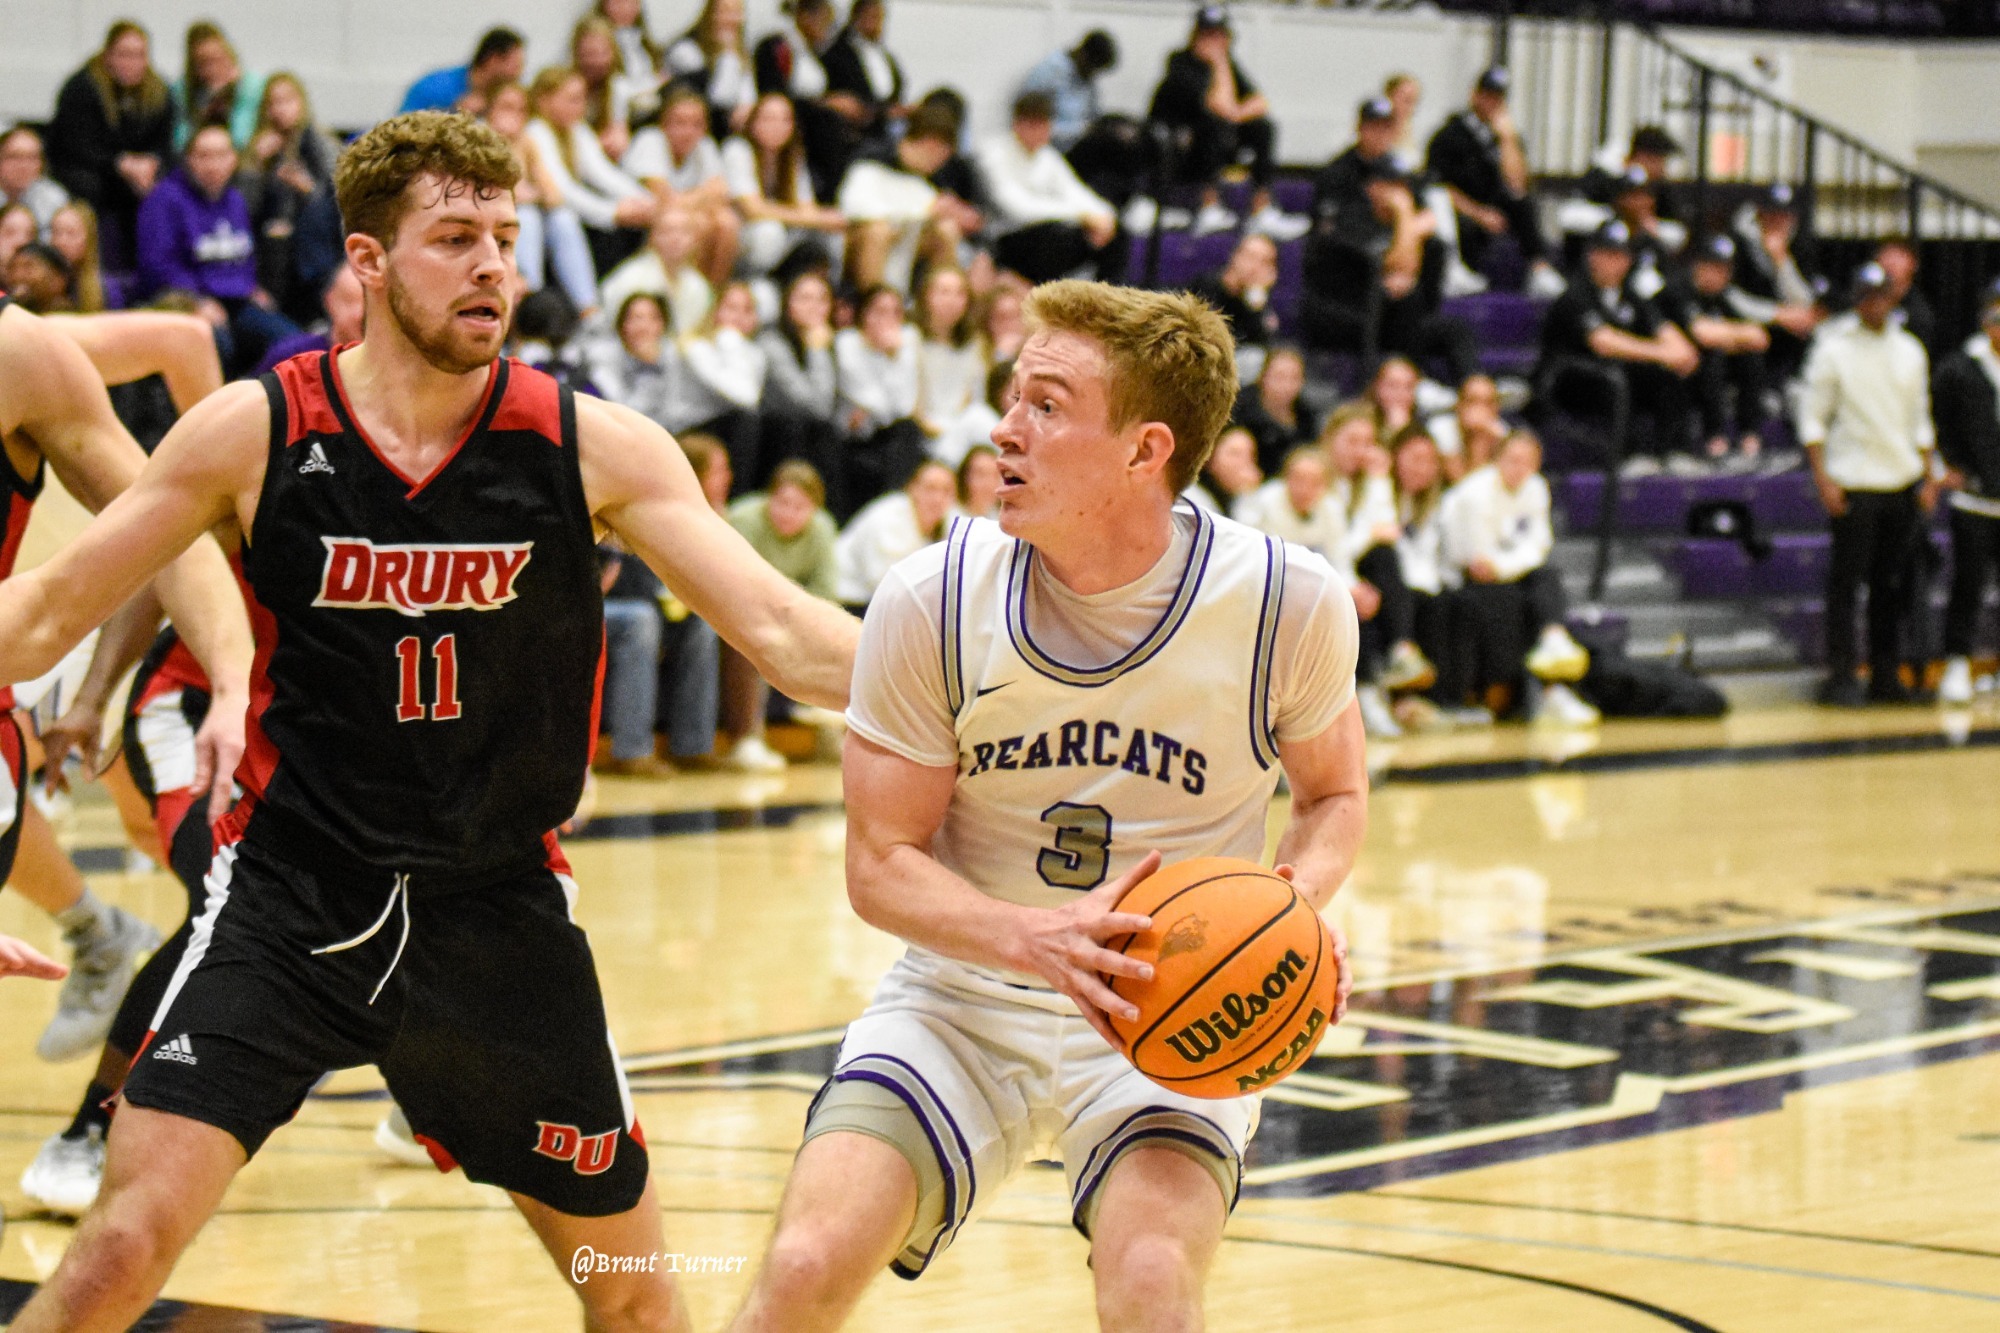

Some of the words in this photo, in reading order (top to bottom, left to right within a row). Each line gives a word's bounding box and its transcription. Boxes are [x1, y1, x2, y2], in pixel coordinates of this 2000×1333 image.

[313, 537, 534, 616] DRURY
[396, 634, 461, 722] 11
[969, 719, 1207, 795] BEARCATS
[1036, 801, 1112, 891] 3
[1164, 949, 1306, 1063] Wilson
[153, 1049, 198, 1065] adidas
[1236, 1007, 1326, 1092] NCAA
[532, 1121, 621, 1175] DU
